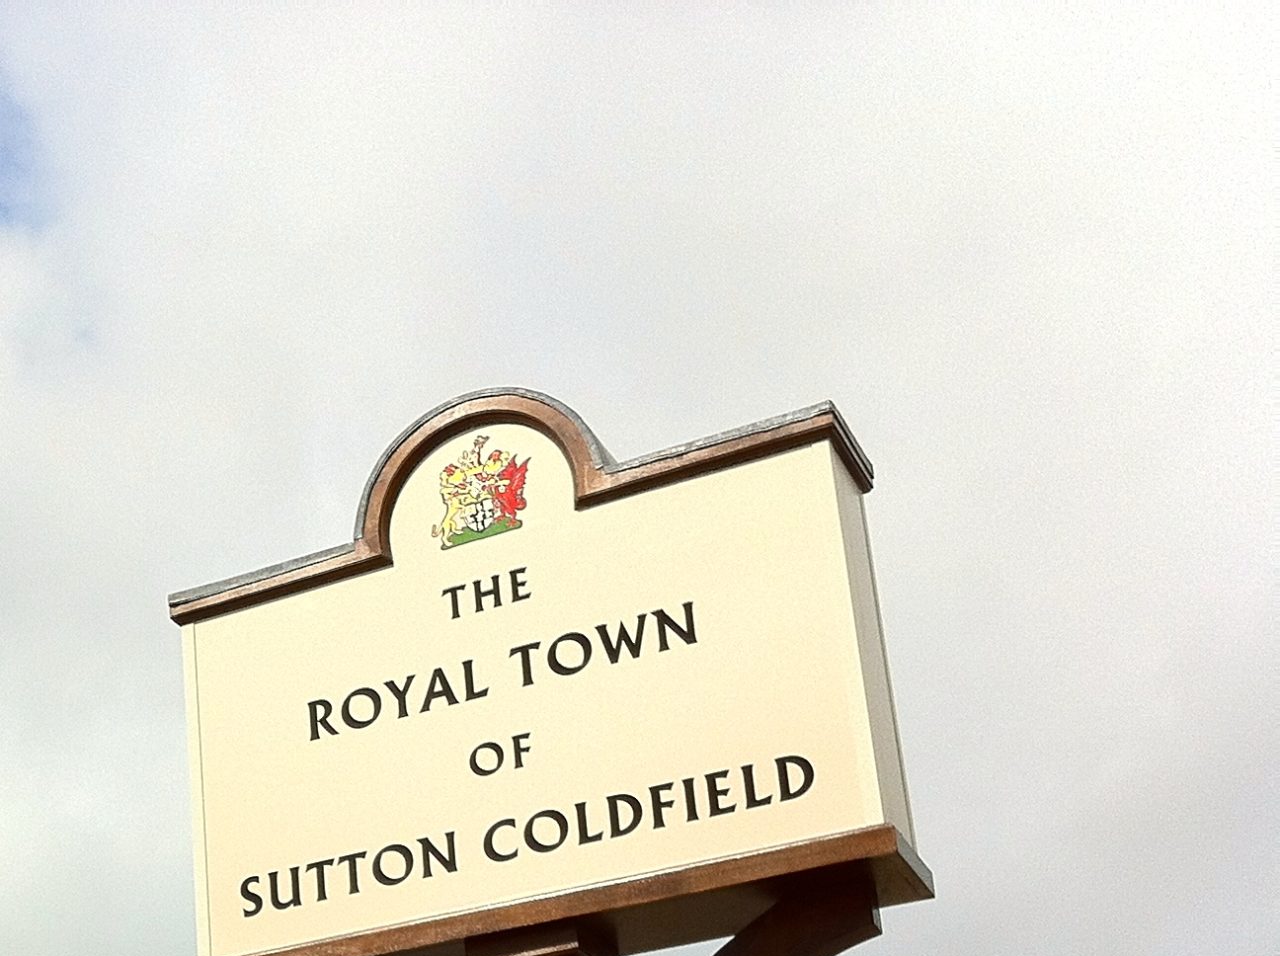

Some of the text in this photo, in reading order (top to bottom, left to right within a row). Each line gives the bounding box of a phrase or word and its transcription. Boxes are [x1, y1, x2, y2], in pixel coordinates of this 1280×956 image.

[441, 566, 532, 620] THE
[307, 601, 698, 742] ROYAL TOWN
[469, 732, 532, 777] OF
[240, 755, 815, 918] SUTTON COLDFIELD
